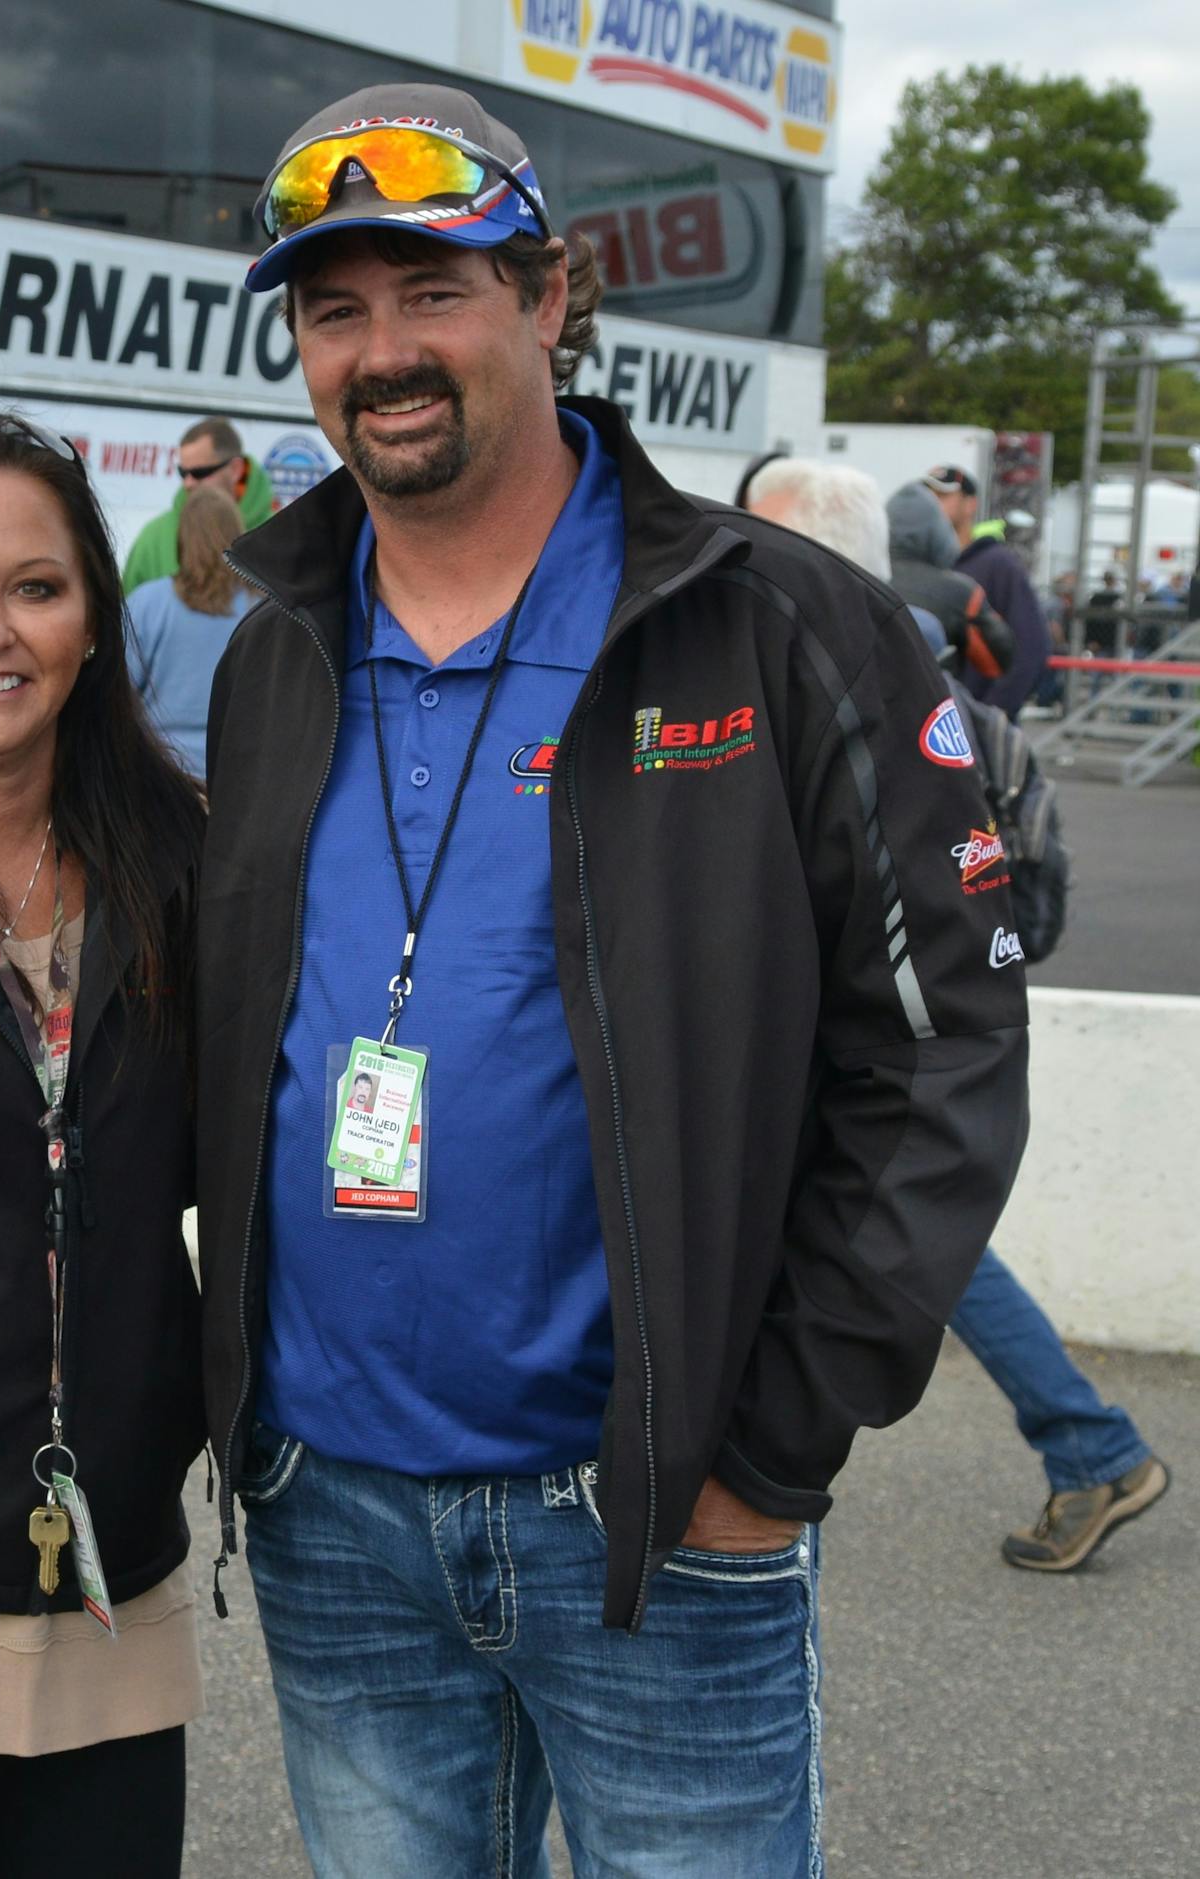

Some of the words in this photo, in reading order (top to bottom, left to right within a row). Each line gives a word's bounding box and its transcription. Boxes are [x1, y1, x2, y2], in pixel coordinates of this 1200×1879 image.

[599, 0, 683, 63] AUTO
[688, 5, 778, 92] PARTS
[786, 59, 829, 124] NAPA
[660, 706, 754, 748] BIR
[684, 730, 753, 759] International
[714, 756, 723, 766] &
[346, 1110, 373, 1125] JOHN
[375, 1118, 400, 1134] (JED)
[347, 1129, 365, 1139] TRACK
[365, 1135, 395, 1148] OPERATOR
[368, 1160, 397, 1180] 2015
[351, 1193, 364, 1201] JED
[365, 1194, 400, 1203] COPHAM
